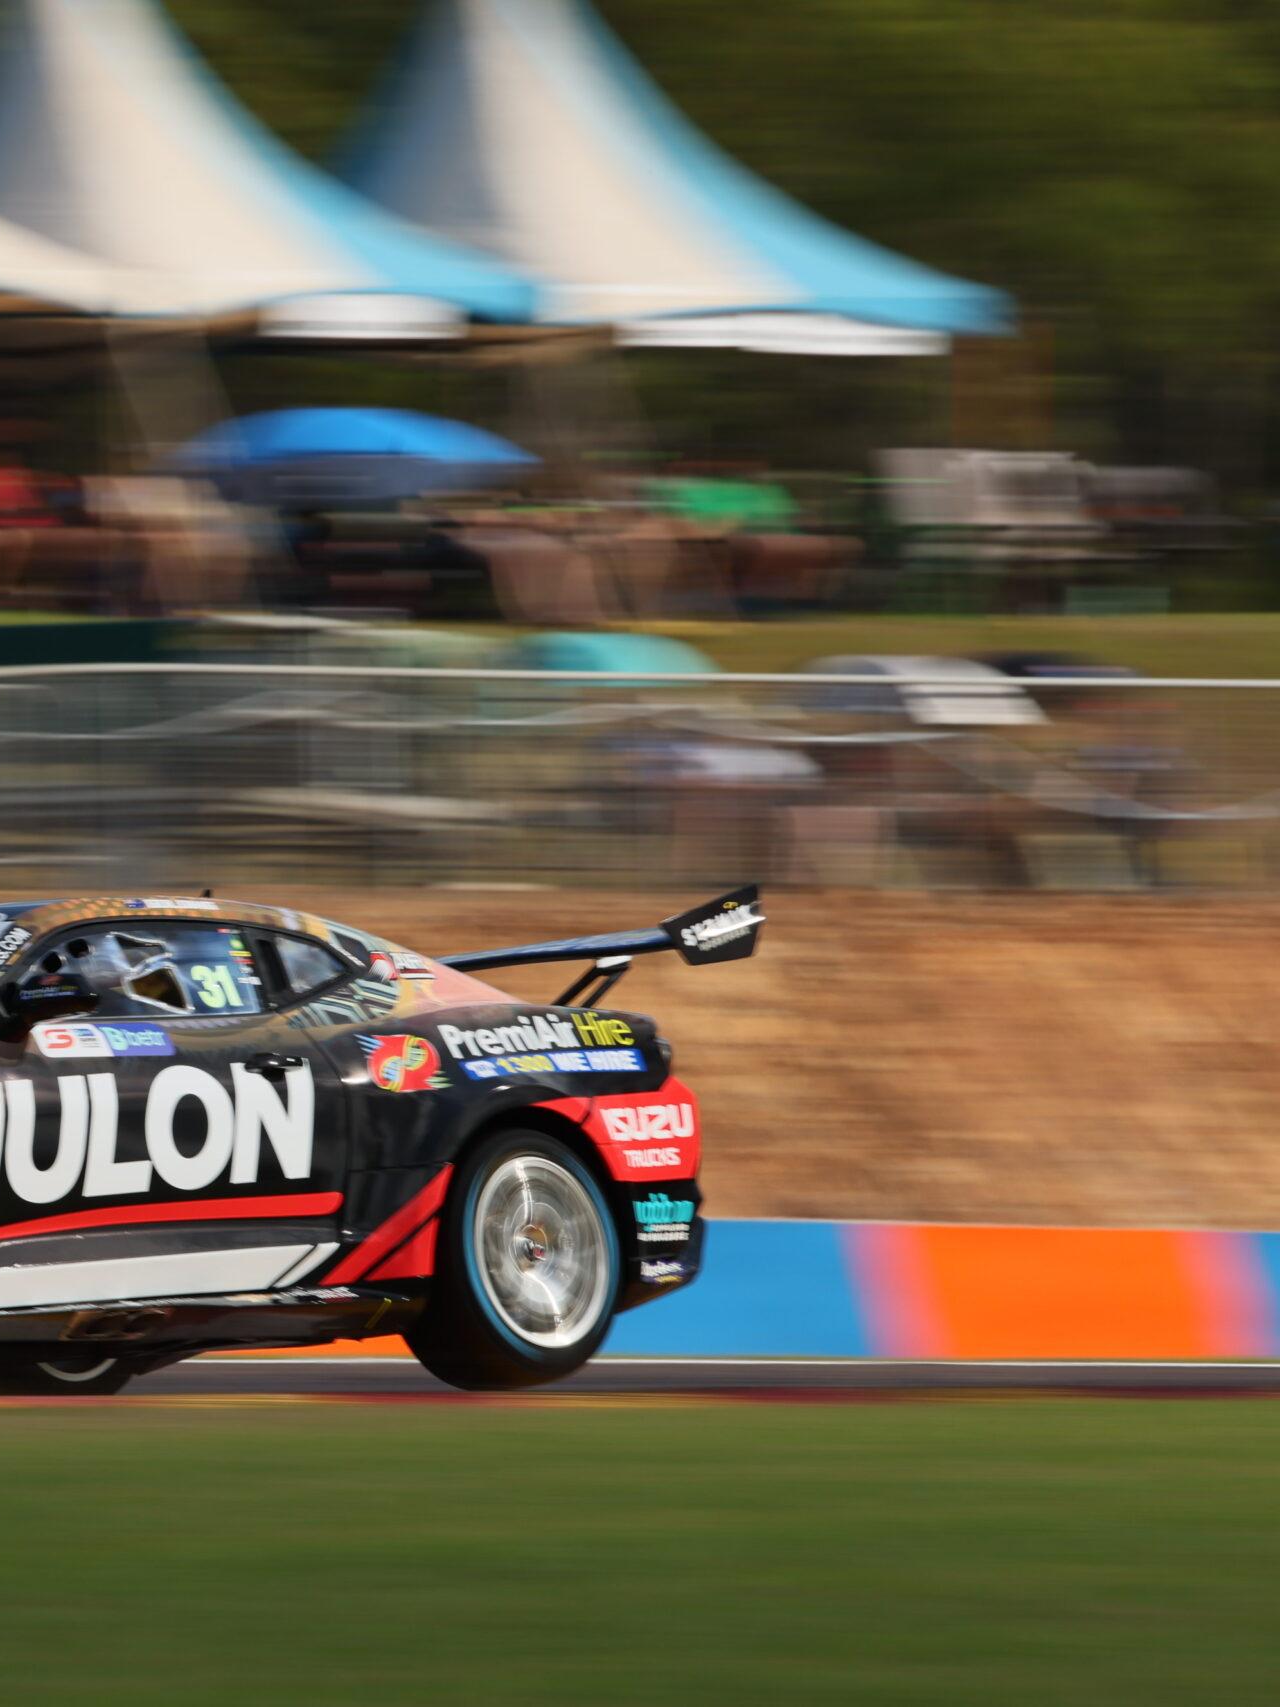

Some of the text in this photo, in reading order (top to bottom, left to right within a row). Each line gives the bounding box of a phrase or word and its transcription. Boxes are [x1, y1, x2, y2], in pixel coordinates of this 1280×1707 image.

[190, 965, 245, 1009] 31
[437, 1012, 635, 1059] PremiAir Hire
[600, 1103, 695, 1141] ISUZU
[622, 1147, 681, 1168] TRUCKS
